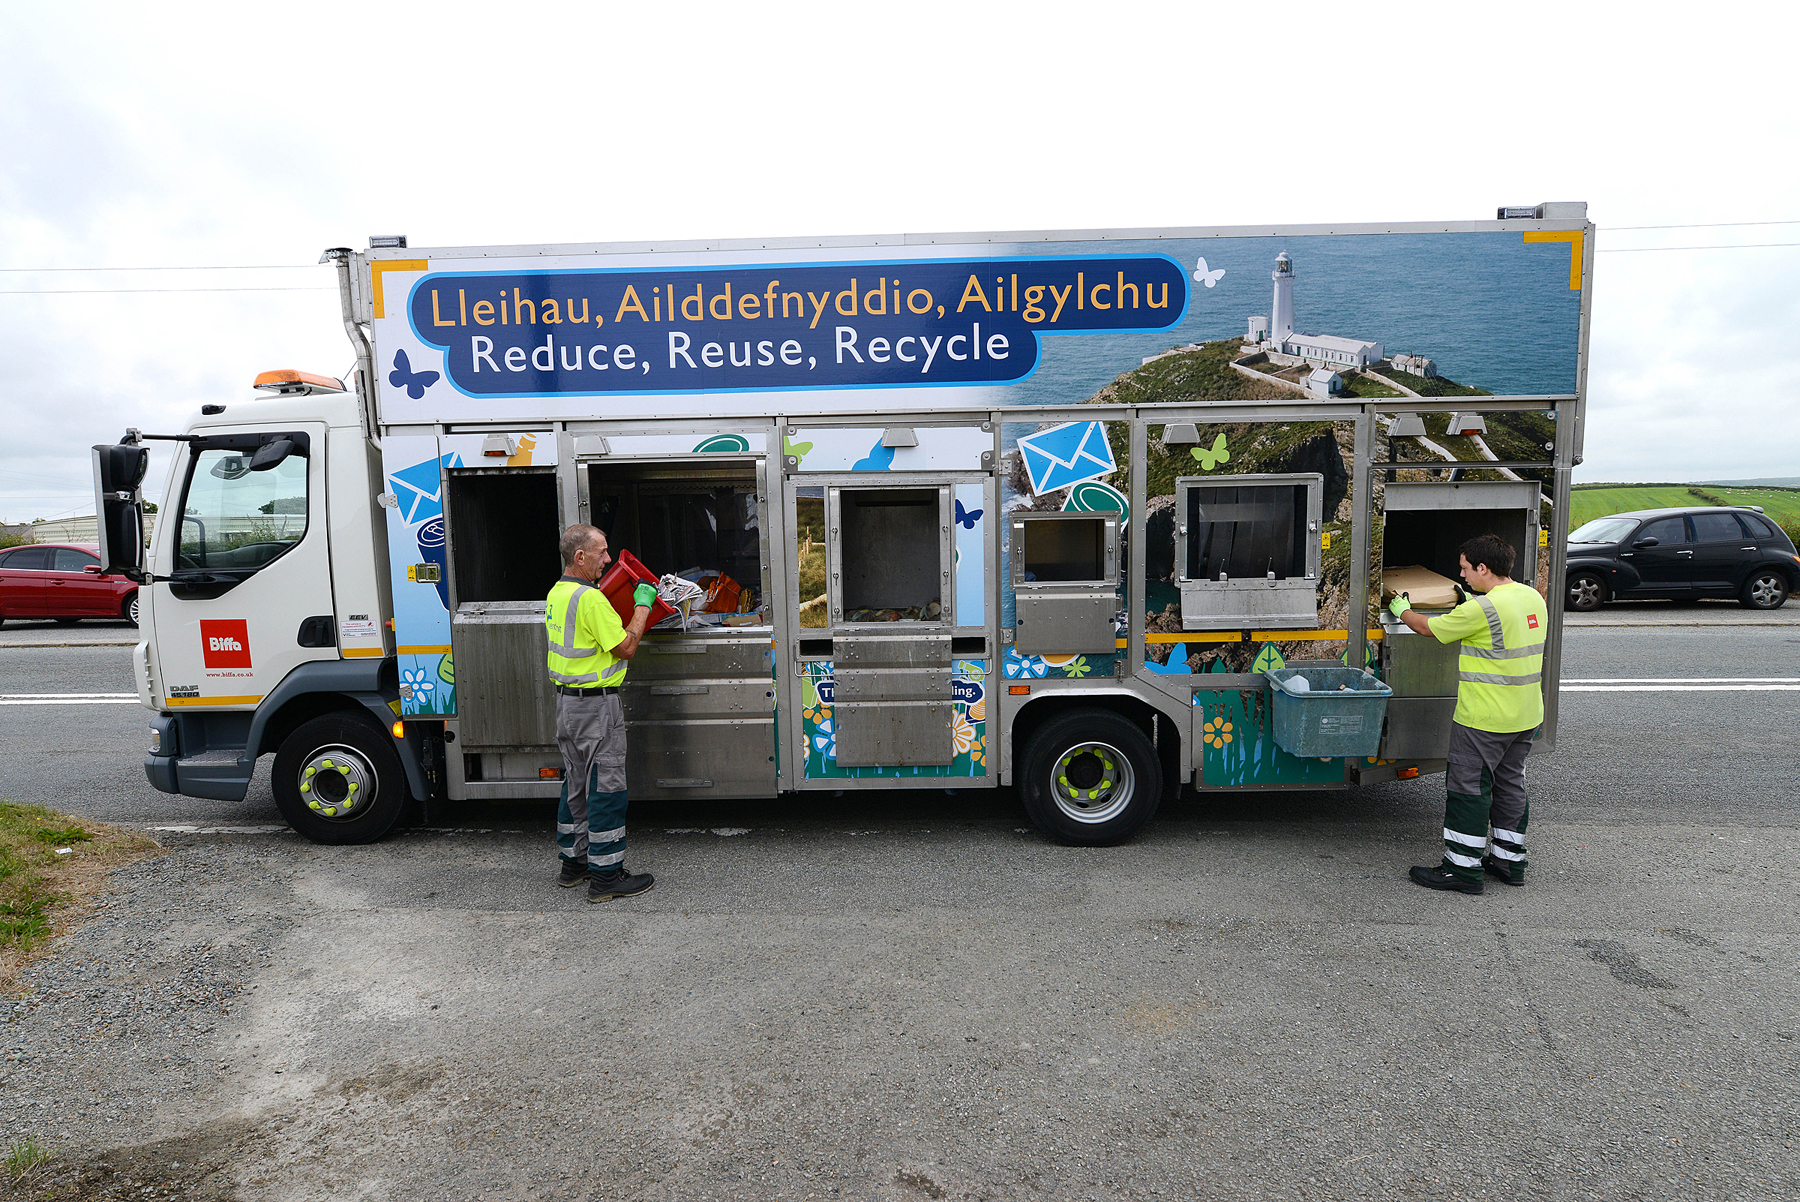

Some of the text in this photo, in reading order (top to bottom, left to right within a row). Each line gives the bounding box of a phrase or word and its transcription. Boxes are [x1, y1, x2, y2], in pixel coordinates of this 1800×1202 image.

[431, 271, 1168, 329] Lleihau, Ailddefnyddio, Ailgylchu
[471, 322, 1010, 375] Reduce, Reuse, Recycle
[209, 637, 242, 651] Biffa
